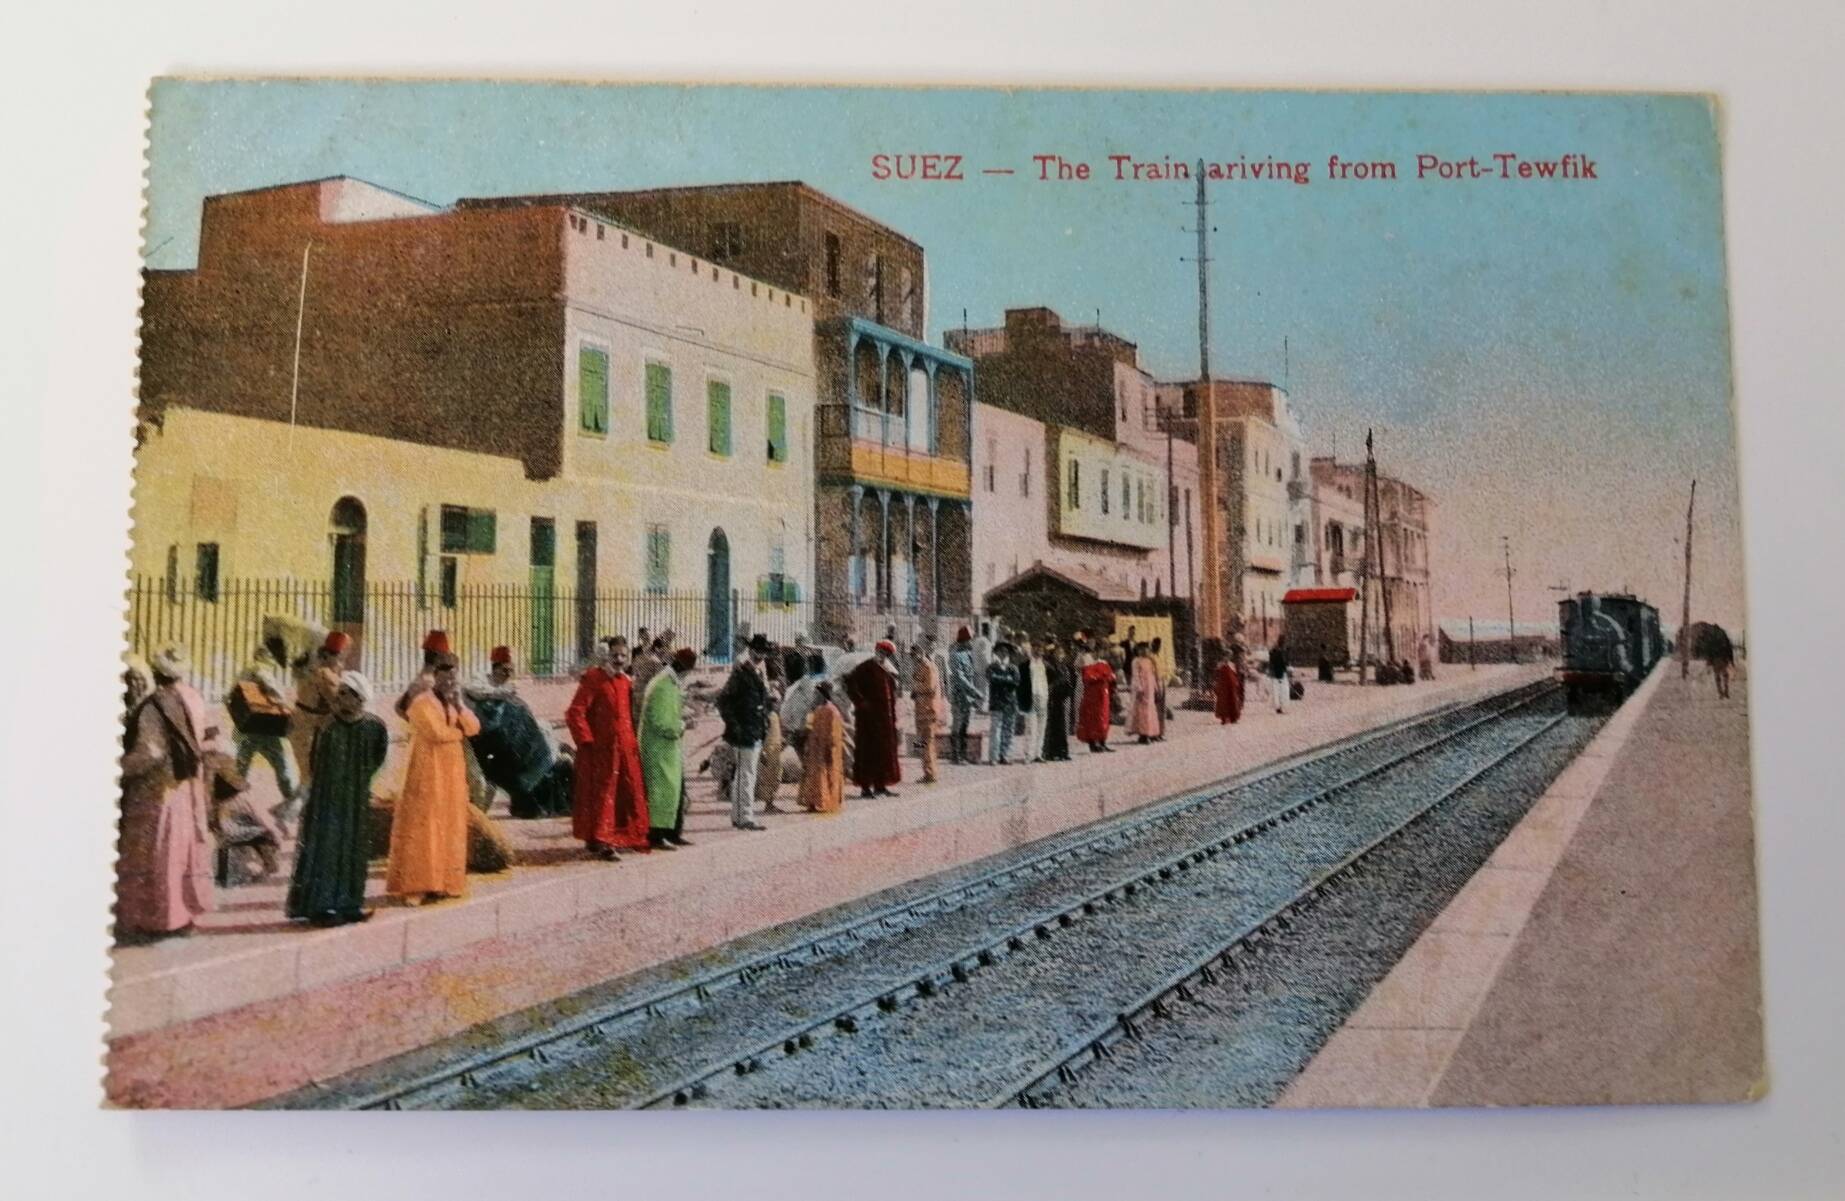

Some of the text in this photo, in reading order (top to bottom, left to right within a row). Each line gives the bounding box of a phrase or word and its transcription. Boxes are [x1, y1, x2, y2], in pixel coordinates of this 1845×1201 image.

[871, 154, 963, 181] SUEZ
[1033, 154, 1090, 181] The
[1108, 154, 1189, 180] Train
[1208, 155, 1311, 185] ariving
[1328, 155, 1397, 179] from
[1416, 153, 1597, 180] Port-Tewfik
